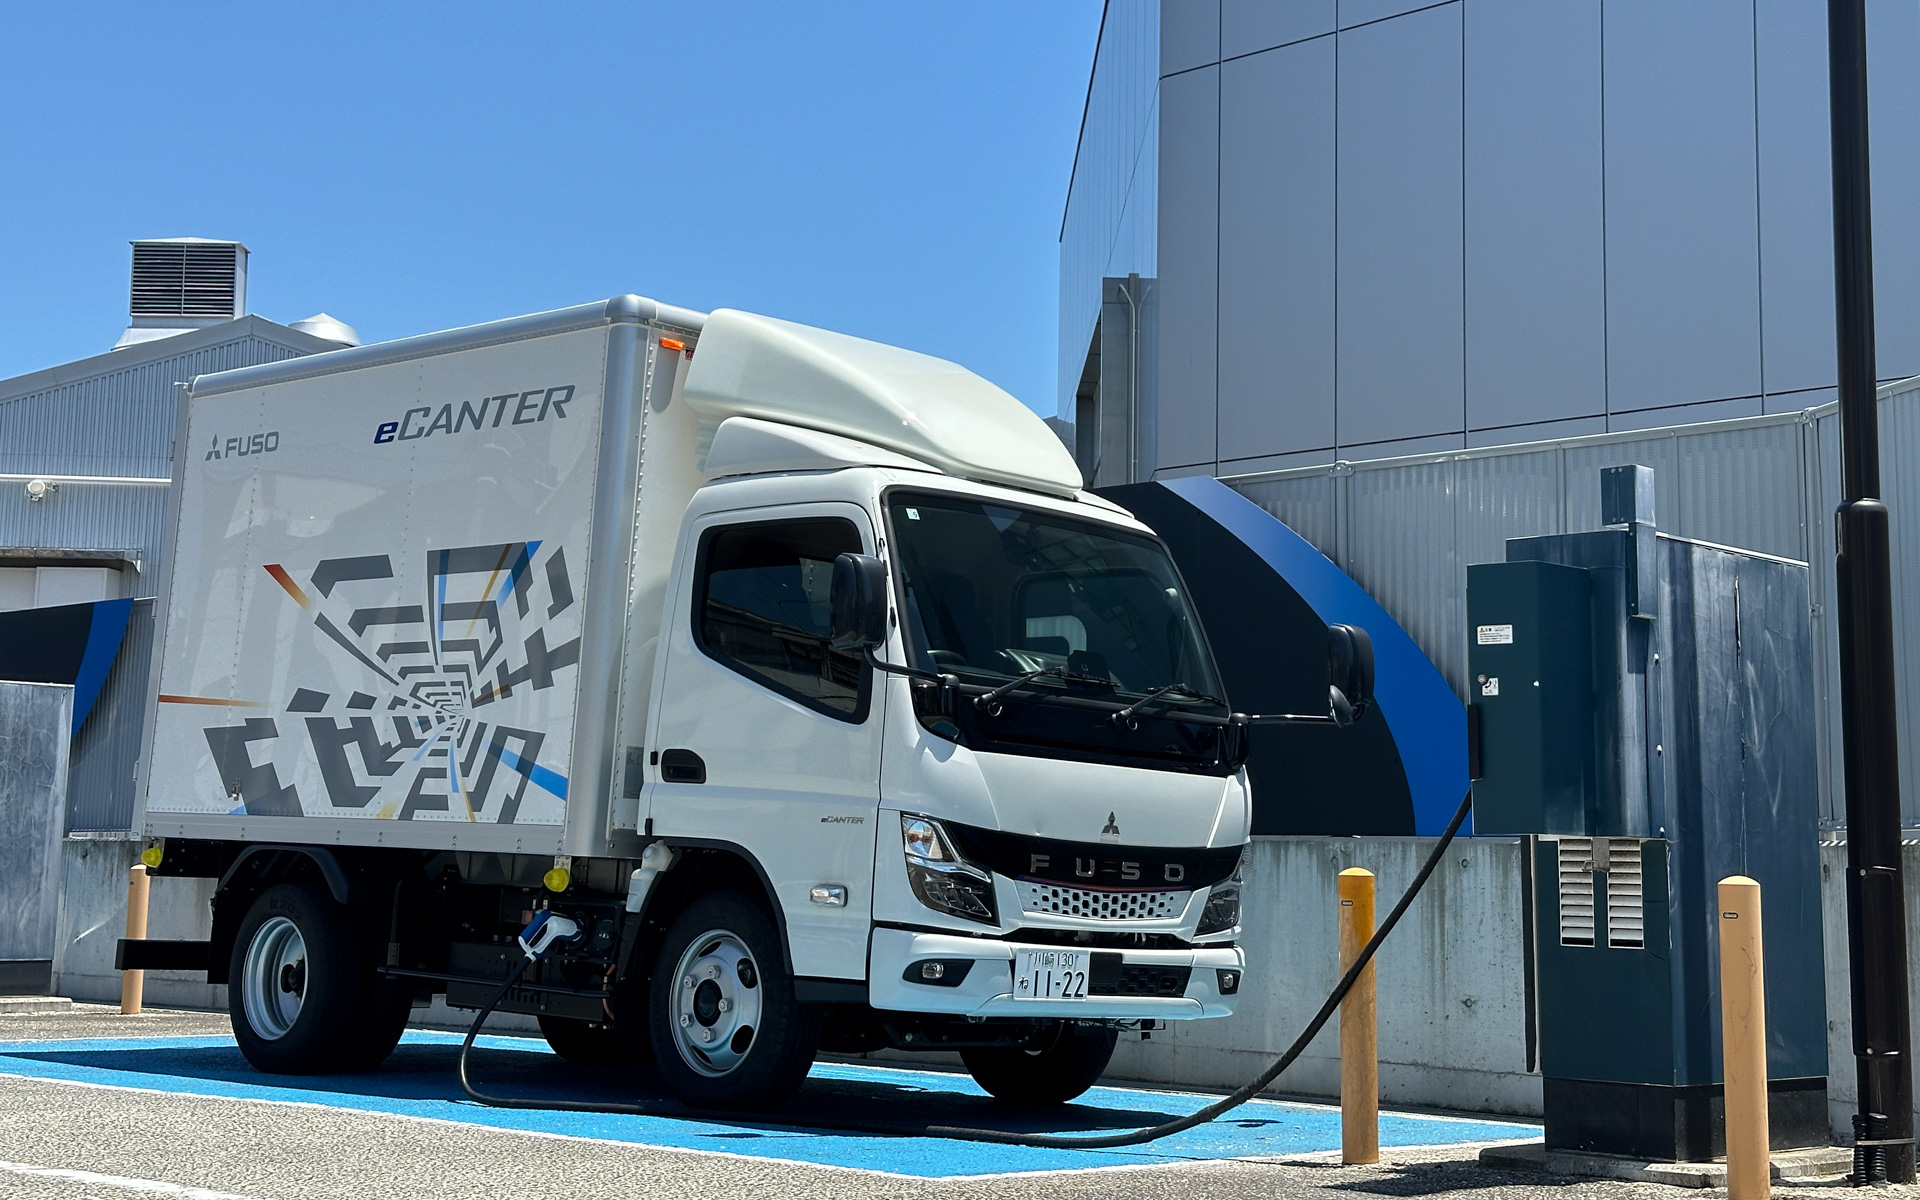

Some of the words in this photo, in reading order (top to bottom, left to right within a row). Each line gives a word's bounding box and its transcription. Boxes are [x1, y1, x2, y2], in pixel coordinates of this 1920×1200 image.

[373, 384, 576, 444] eCANTER
[224, 431, 279, 459] FUSO
[1030, 854, 1184, 882] FUSO
[1057, 952, 1074, 967] 130
[1033, 970, 1085, 998] 11-22
